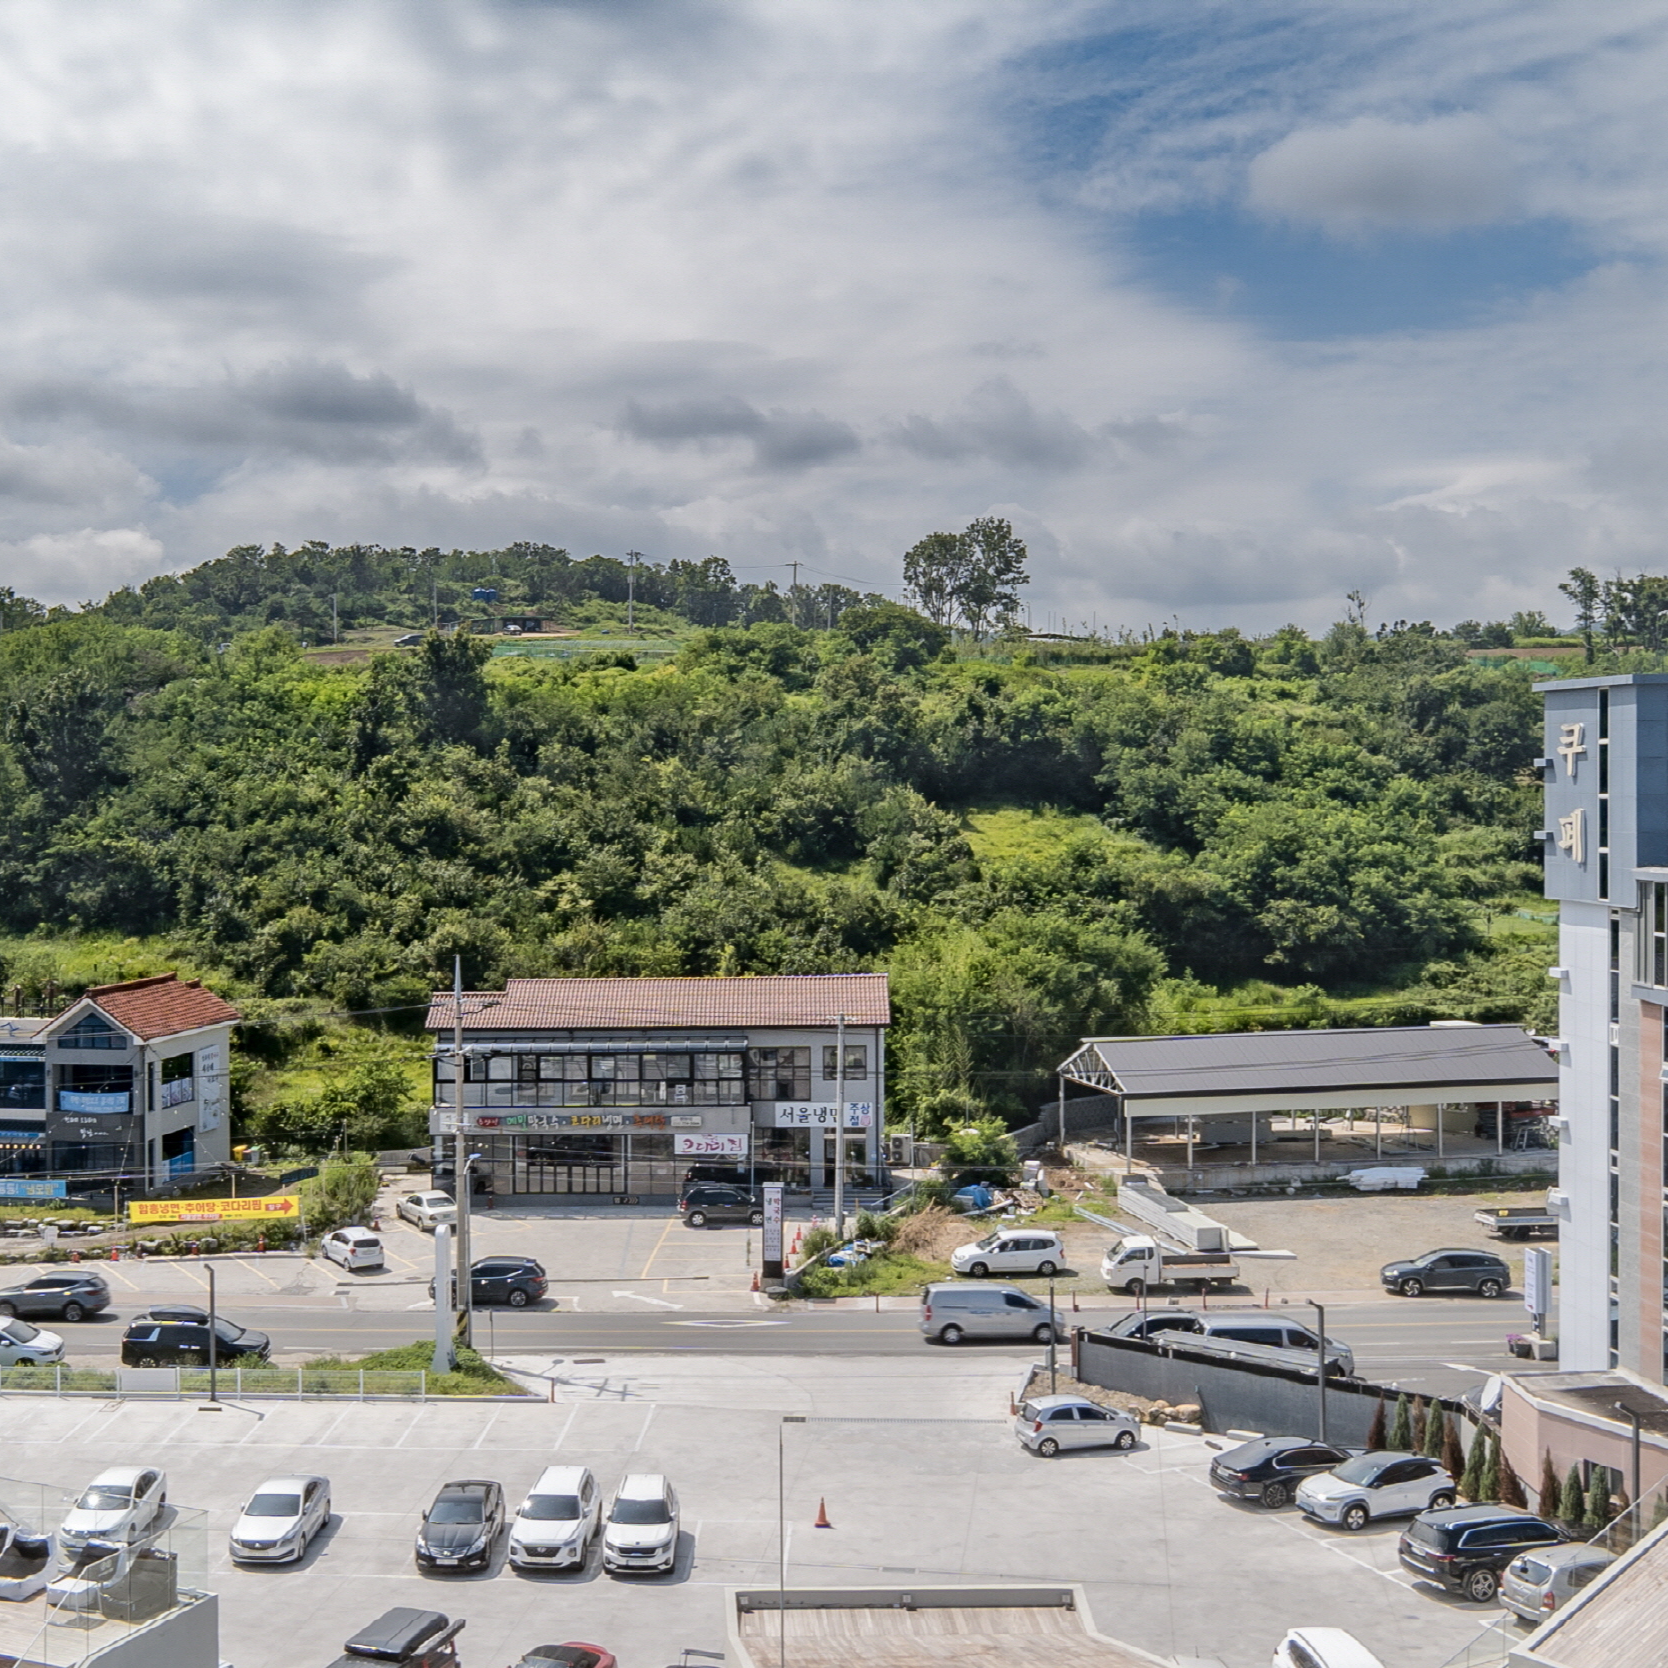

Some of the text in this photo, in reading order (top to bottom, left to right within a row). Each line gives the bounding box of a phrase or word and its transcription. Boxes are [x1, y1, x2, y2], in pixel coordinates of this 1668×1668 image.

[1557, 723, 1587, 864] 쿠페
[506, 1114, 560, 1131] 메밀막국수
[570, 1114, 624, 1130] 코다리냉면
